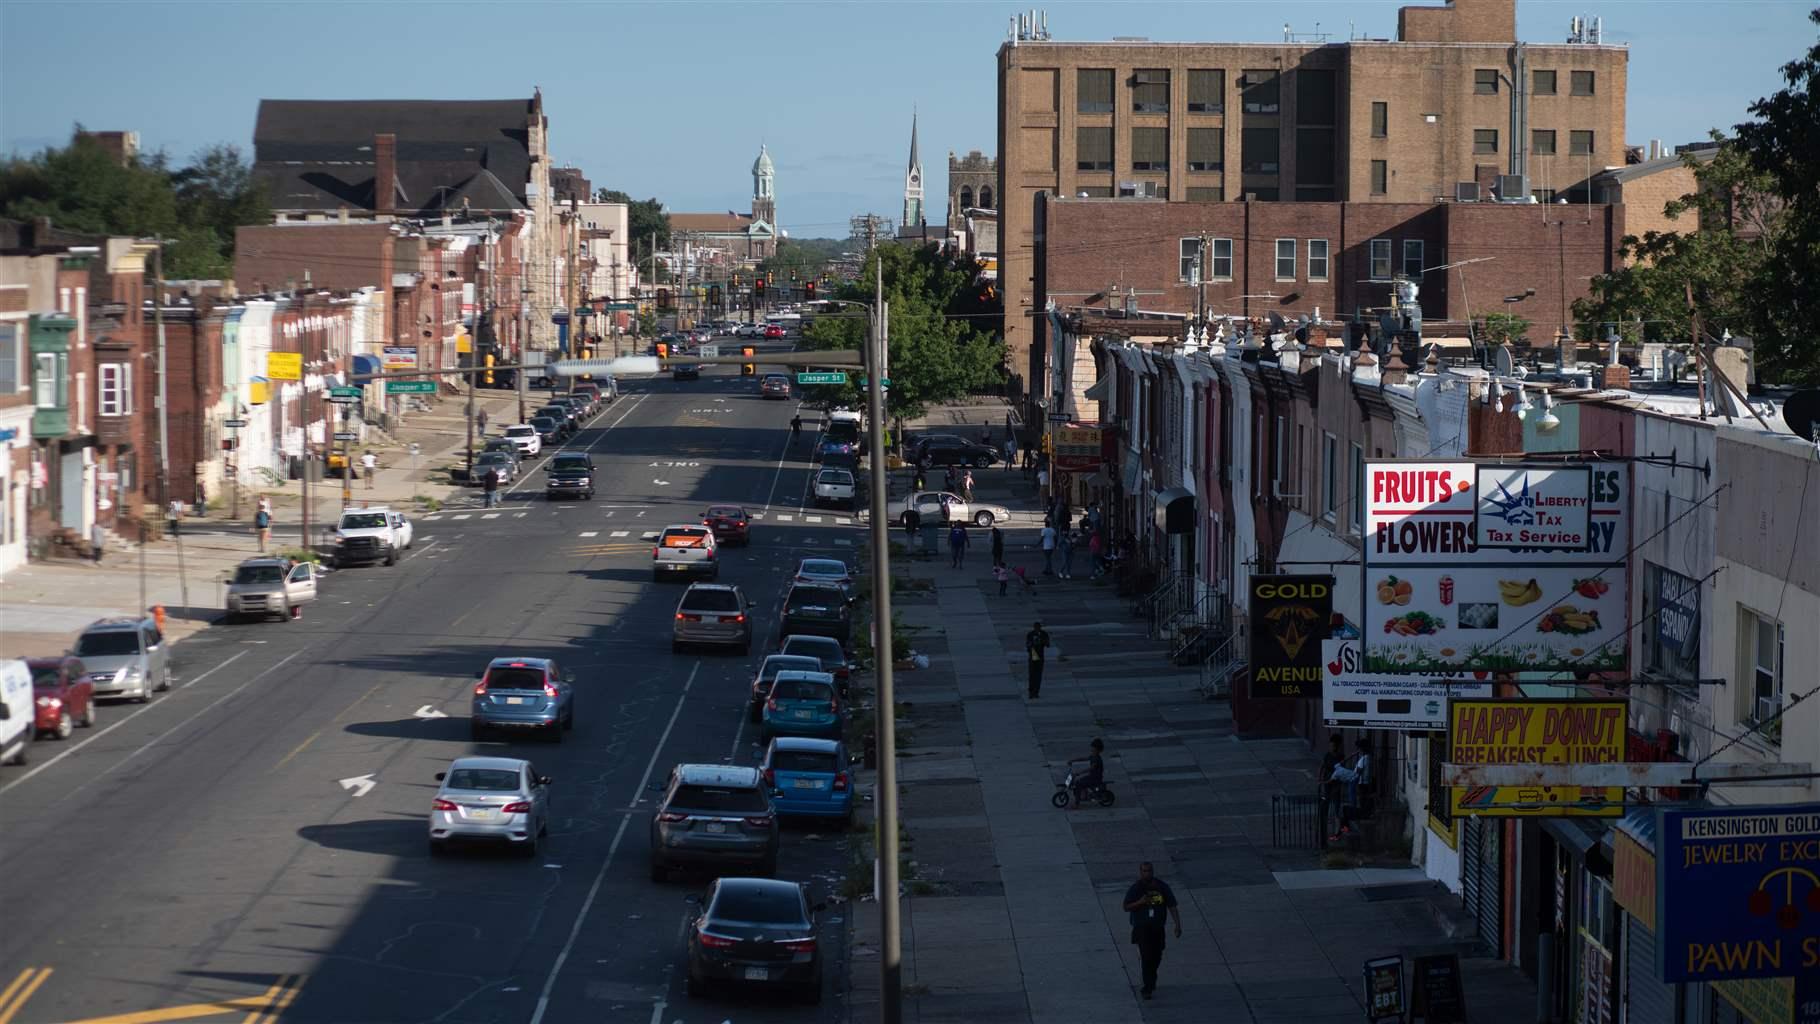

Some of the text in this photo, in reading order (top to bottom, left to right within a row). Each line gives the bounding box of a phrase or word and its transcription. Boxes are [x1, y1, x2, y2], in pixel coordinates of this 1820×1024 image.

[1373, 471, 1452, 503] FRUITS
[1376, 521, 1479, 553] FLOWERS
[1486, 529, 1513, 542] Tax
[1519, 530, 1581, 543] Service
[1255, 583, 1328, 599] GOLD
[1281, 684, 1301, 695] USA
[1455, 707, 1622, 746] HAPPY DONUT
[1688, 815, 1820, 836] KENSINGTON GOLD
[1682, 840, 1820, 869] JEWELRY EXC
[1687, 938, 1782, 974] PAWN
[1375, 991, 1397, 1008] EBT
